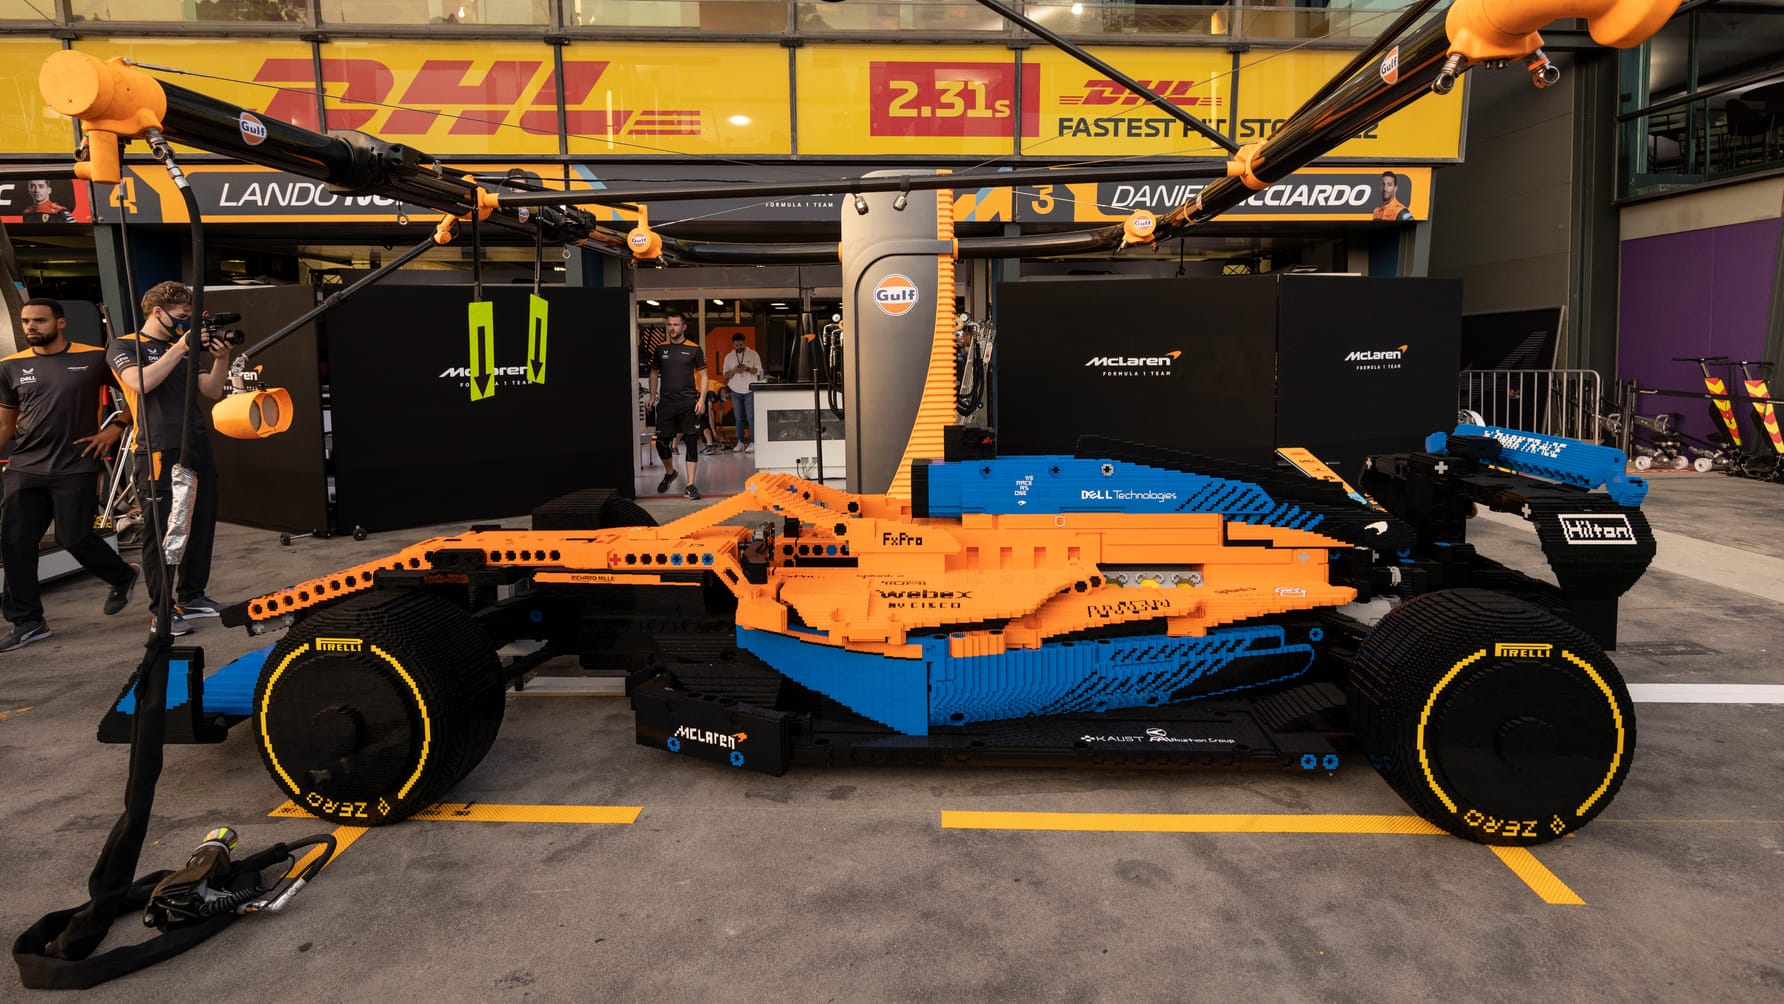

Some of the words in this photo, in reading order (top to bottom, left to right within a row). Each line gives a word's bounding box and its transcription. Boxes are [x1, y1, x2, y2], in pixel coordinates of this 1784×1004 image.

[252, 58, 633, 136] DHL
[888, 80, 1011, 118] 2.31s
[1082, 80, 1200, 105] DHL
[241, 121, 265, 136] Gulf
[1058, 118, 1177, 138] FASTEST
[109, 177, 138, 214] 4
[1031, 184, 1055, 215] 3
[1110, 185, 1203, 207] DANIE
[876, 289, 916, 301] Gulf
[1085, 356, 1171, 366] McLaren
[1344, 350, 1402, 361] McLaren
[1081, 490, 1113, 500] DELL
[1113, 490, 1177, 502] Technologies
[1565, 520, 1629, 538] Hilton
[883, 532, 923, 546] FxPro
[316, 637, 363, 652] PIRELLI
[1495, 643, 1553, 658] PIRELLI
